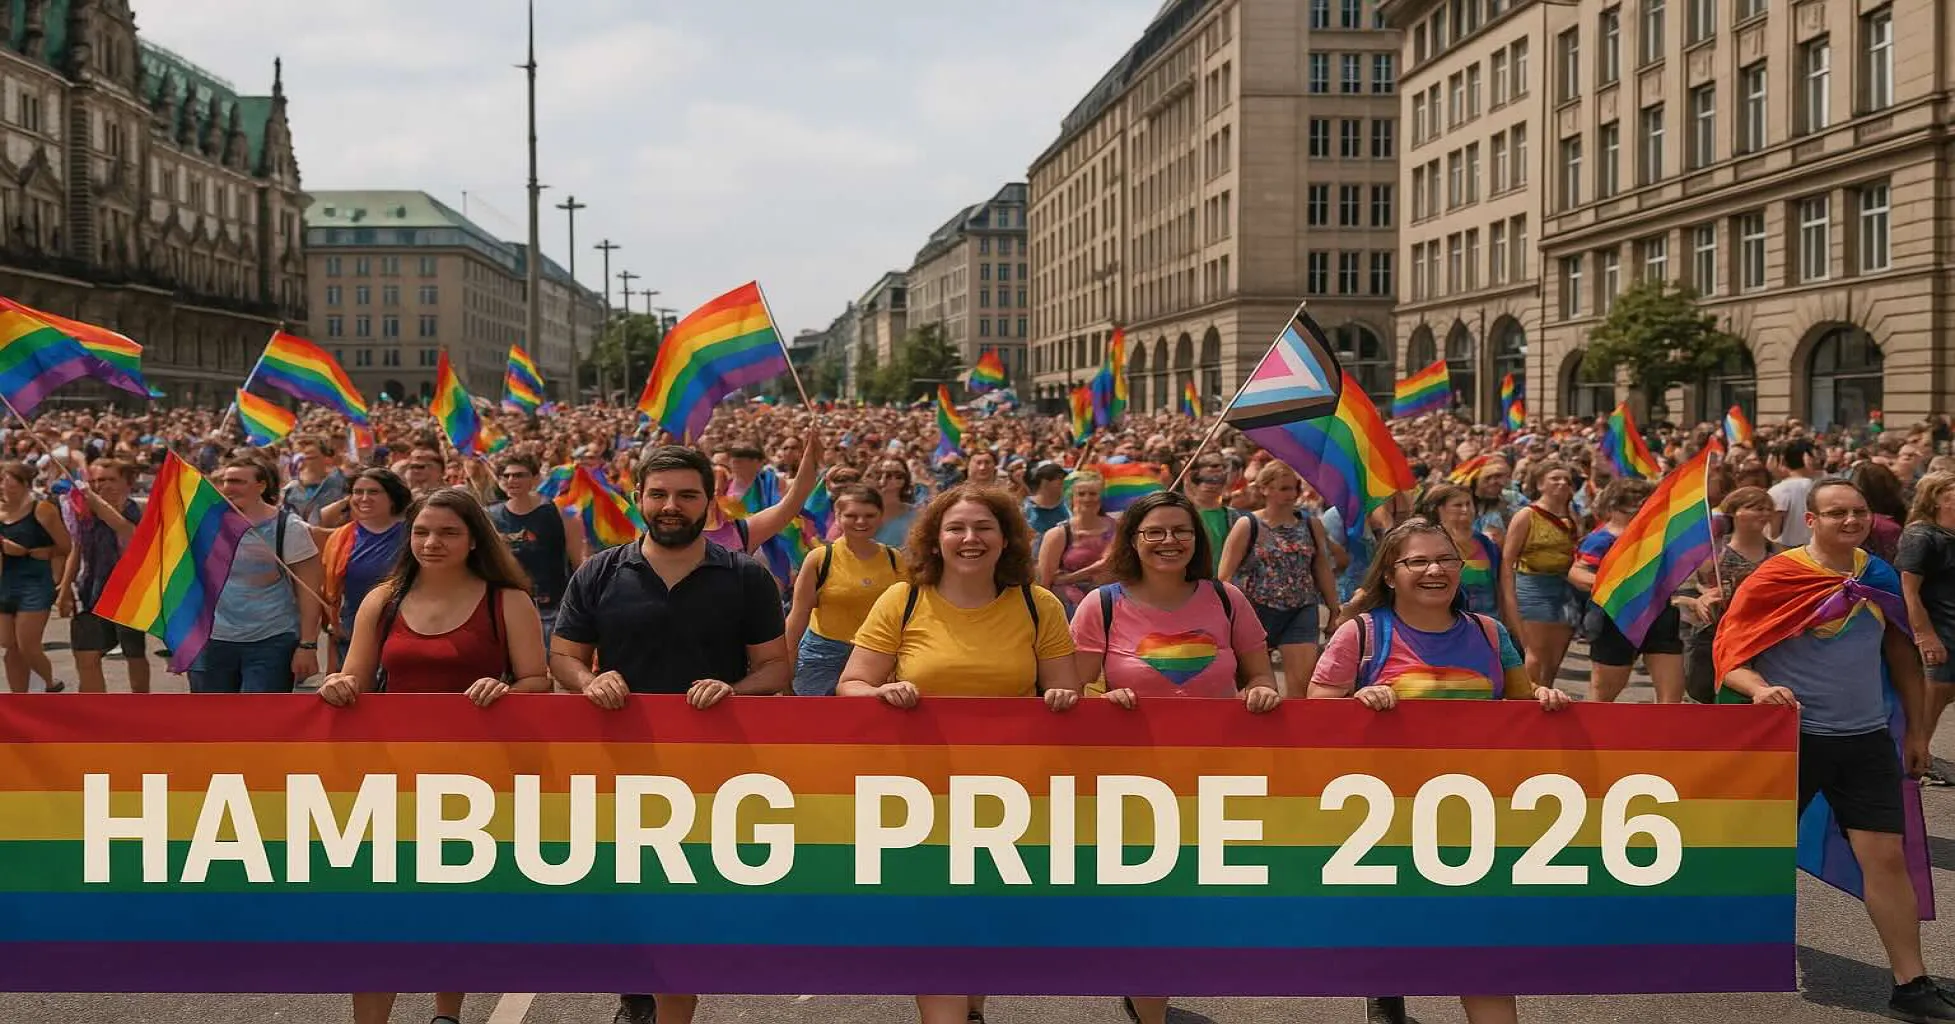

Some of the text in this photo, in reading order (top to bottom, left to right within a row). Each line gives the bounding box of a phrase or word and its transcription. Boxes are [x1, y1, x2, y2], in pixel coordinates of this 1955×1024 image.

[82, 773, 1684, 887] HAMBURG PRIDE 2026
